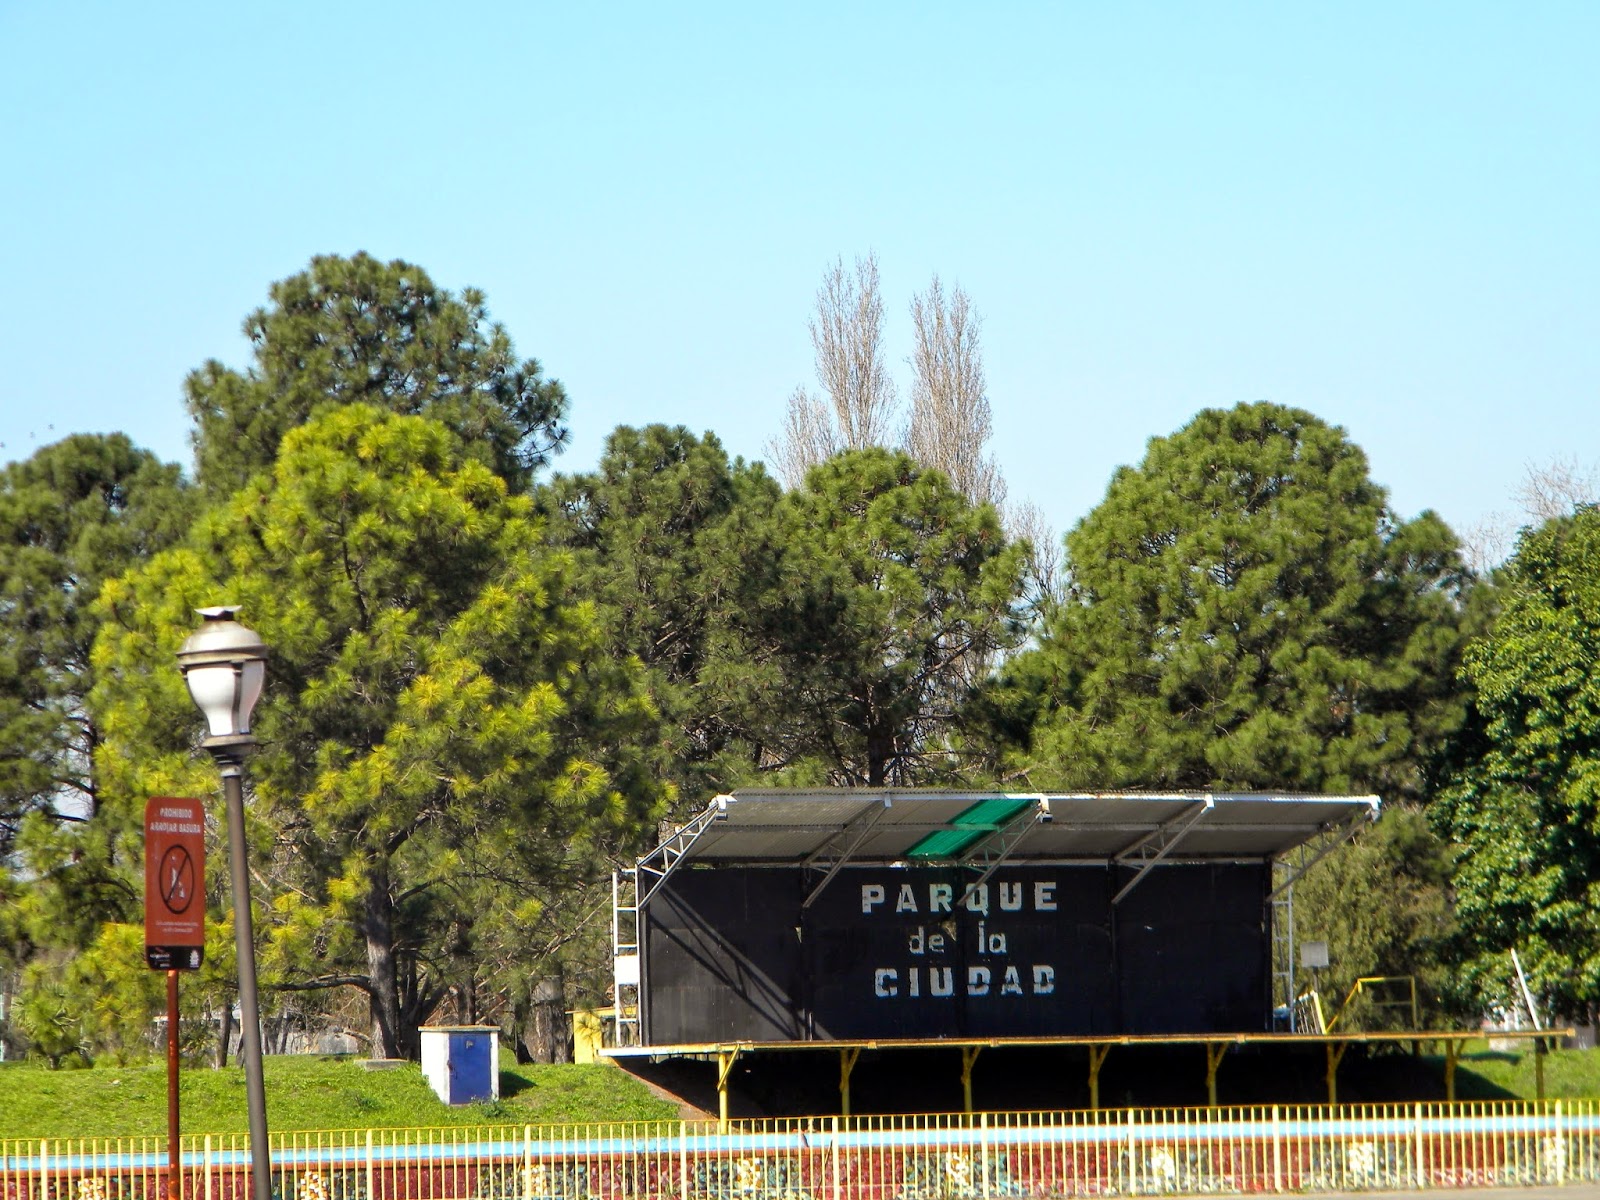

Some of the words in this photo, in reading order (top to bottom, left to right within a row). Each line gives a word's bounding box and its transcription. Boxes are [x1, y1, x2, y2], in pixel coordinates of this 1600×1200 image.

[160, 807, 192, 819] PROHIBIDO
[861, 881, 1058, 917] PARQUE
[908, 925, 945, 954] de
[978, 920, 1007, 954] la
[874, 964, 1055, 998] CIUDAD
